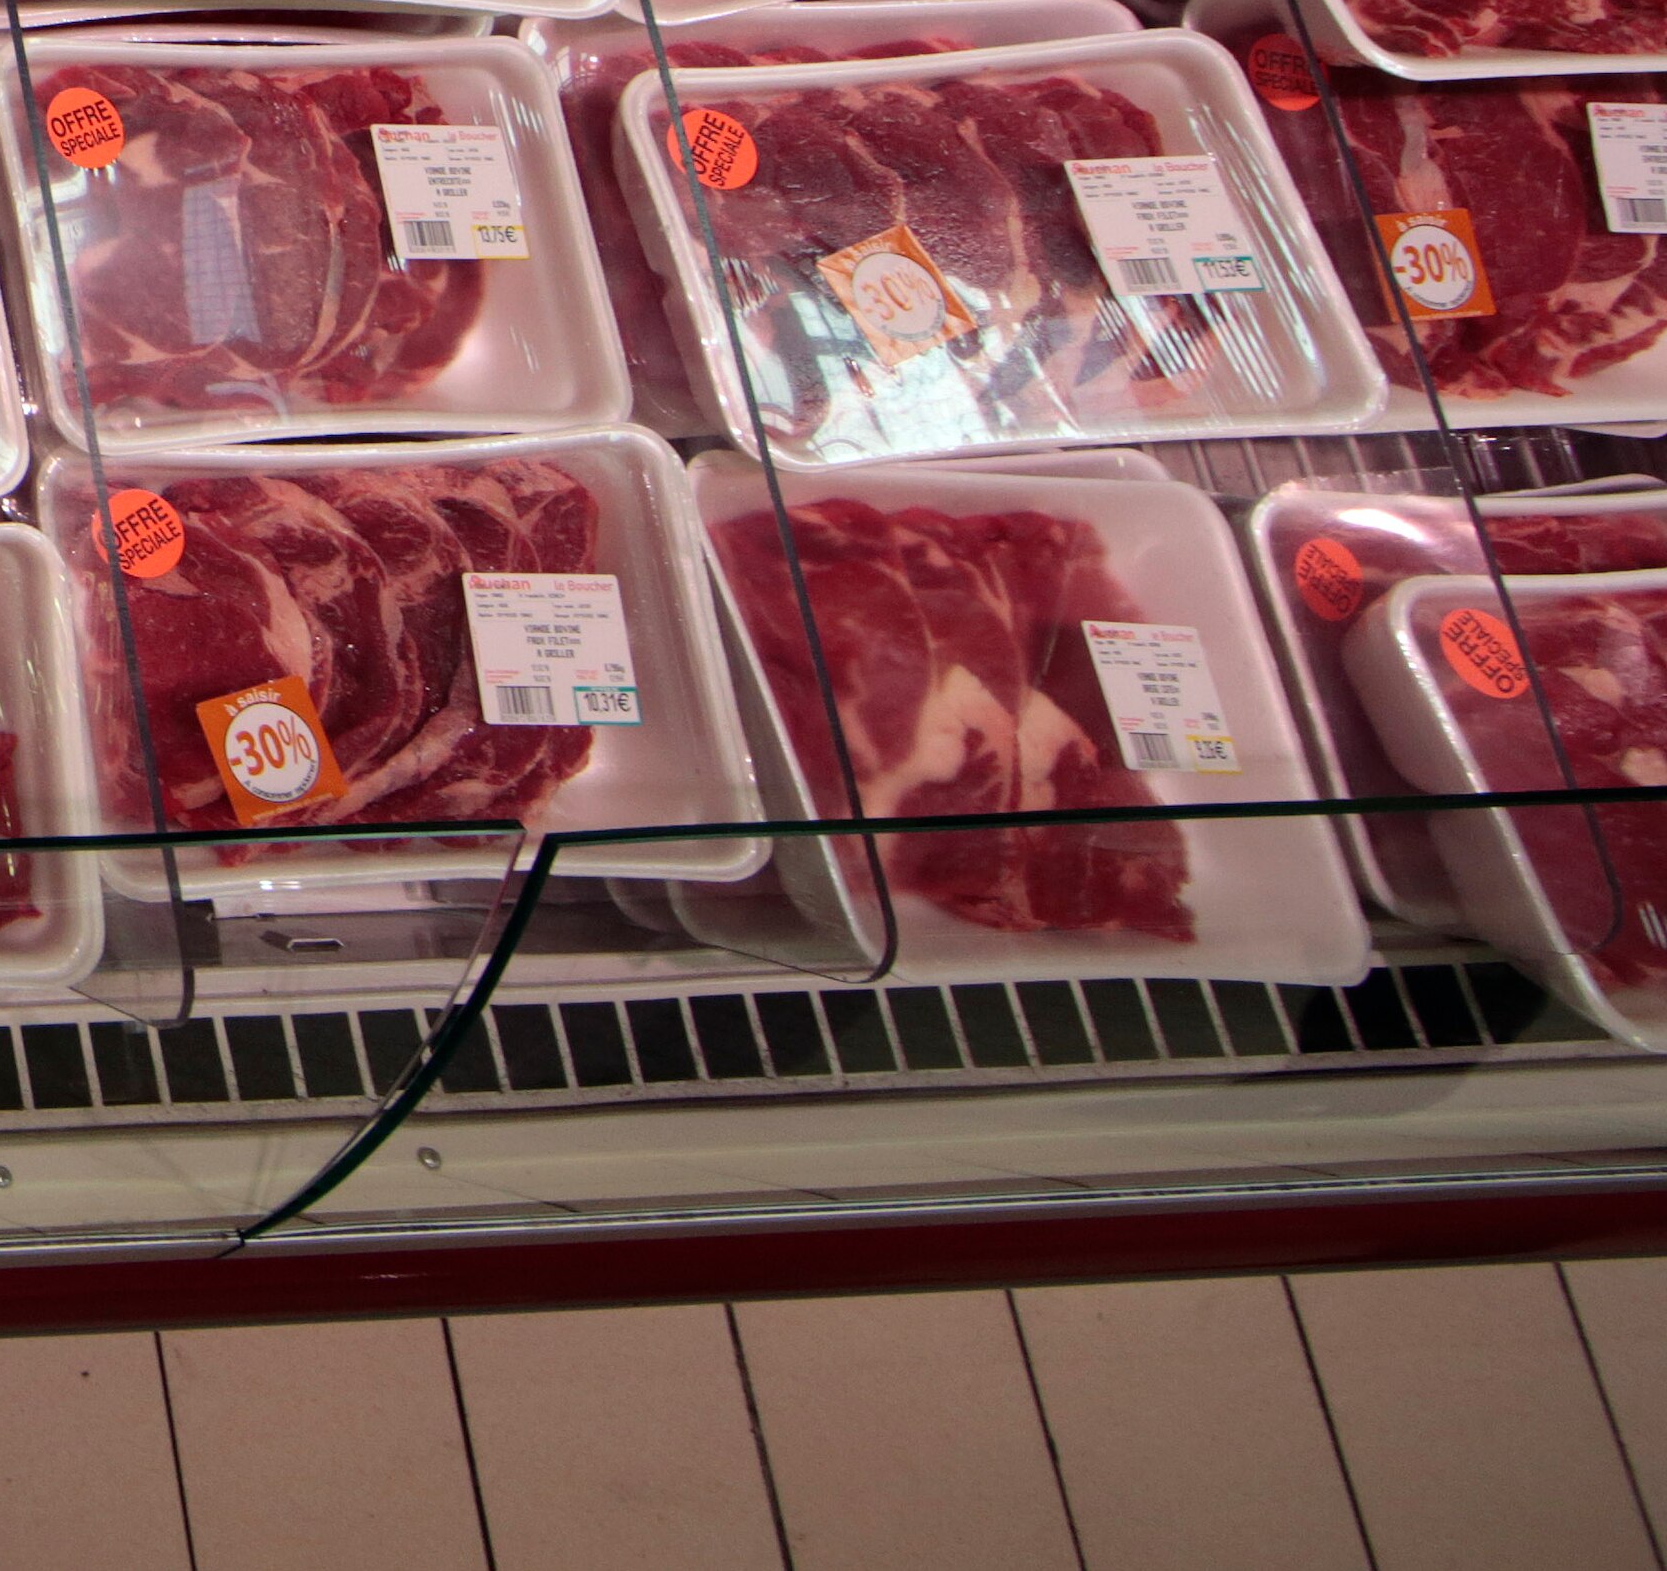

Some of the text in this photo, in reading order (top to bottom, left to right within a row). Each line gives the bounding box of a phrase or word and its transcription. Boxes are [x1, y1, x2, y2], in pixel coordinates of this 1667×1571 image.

[52, 99, 113, 139] OFFRE
[60, 121, 122, 158] SPECIALE
[708, 125, 745, 187] SPECIALE
[1444, 622, 1515, 695] OFFRE
[229, 715, 312, 776] -30%
